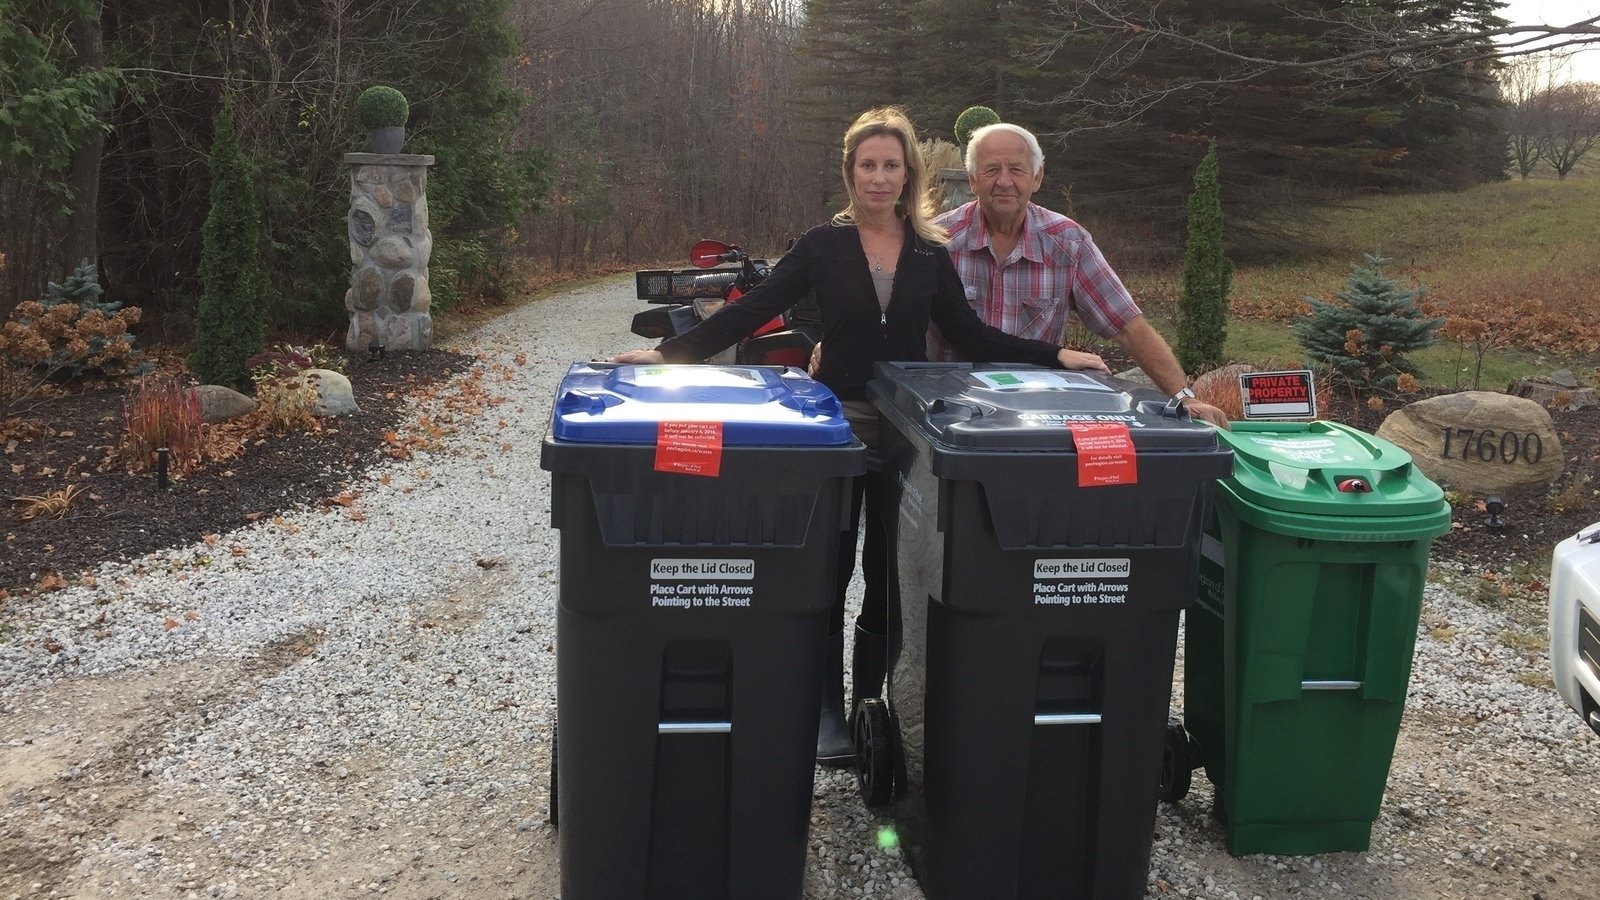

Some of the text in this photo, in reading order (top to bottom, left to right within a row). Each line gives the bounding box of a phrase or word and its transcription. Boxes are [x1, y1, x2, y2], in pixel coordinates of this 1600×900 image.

[1252, 376, 1300, 387] PRIVATE
[1249, 386, 1307, 398] PROPERTY
[1441, 427, 1542, 464] 17600
[653, 563, 752, 576] Keep the Lid Closed
[1036, 562, 1129, 575] Keep the Lid Closed
[650, 584, 754, 594] Place Cart with Arrows
[1033, 582, 1129, 593] Place Cart with Arrows
[652, 596, 751, 609] Pointing to the Street
[1034, 593, 1126, 606] Pointing to the Street
